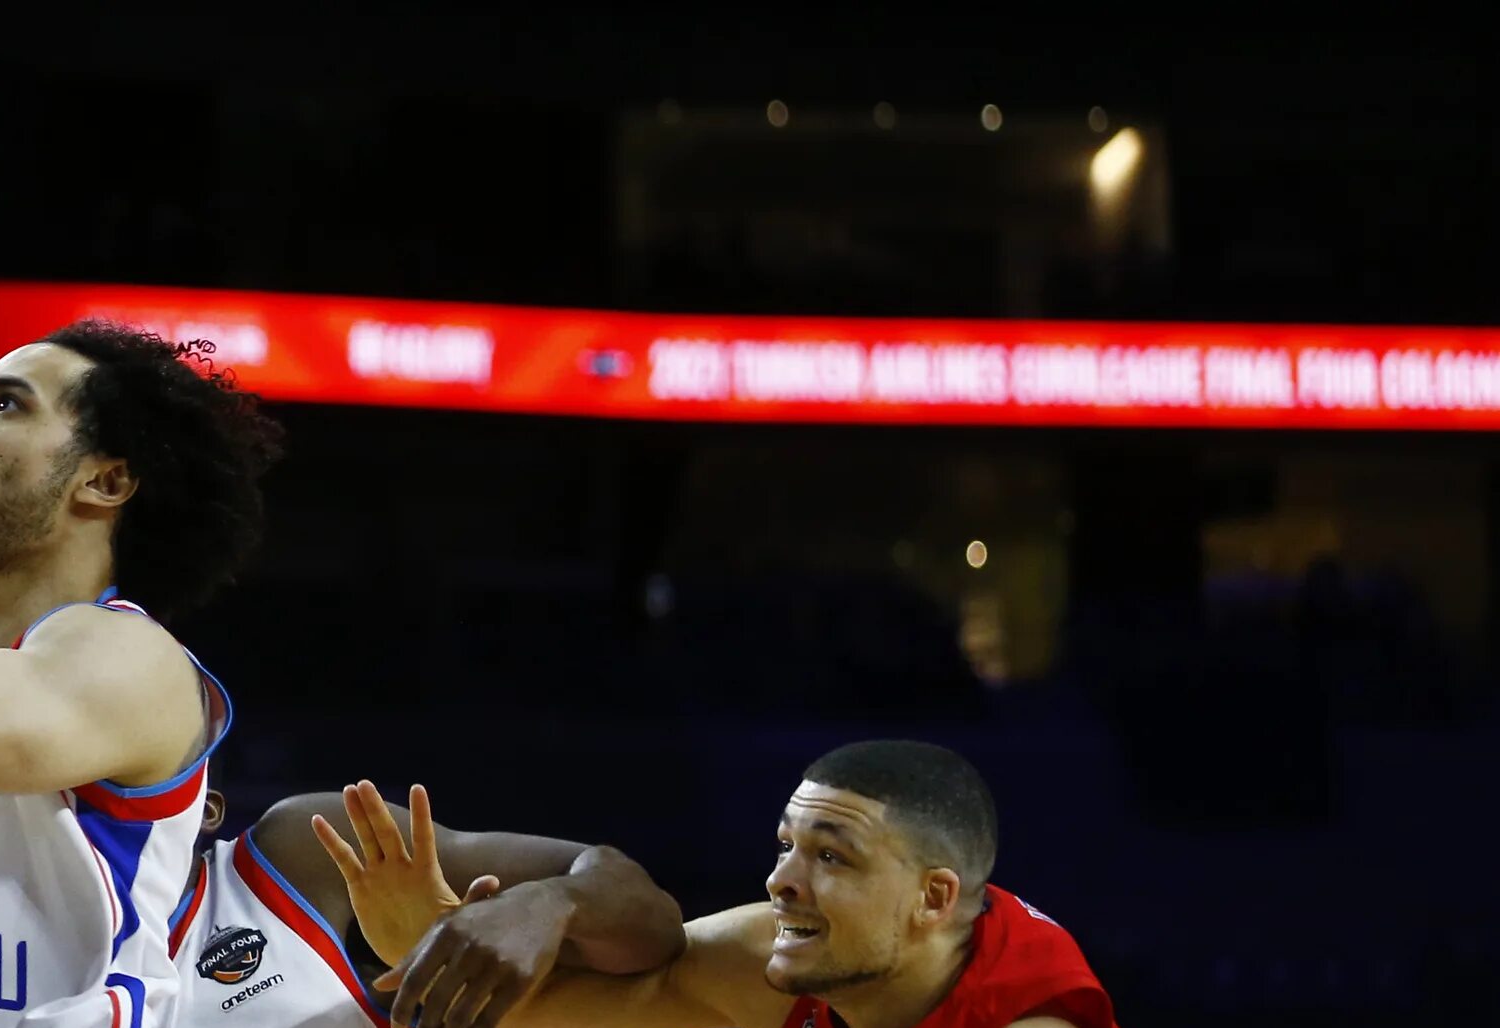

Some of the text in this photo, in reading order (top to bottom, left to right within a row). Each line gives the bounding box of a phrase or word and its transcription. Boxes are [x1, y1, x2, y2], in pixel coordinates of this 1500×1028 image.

[201, 934, 261, 972] FINAL FOUR
[221, 973, 285, 1010] oneteam
